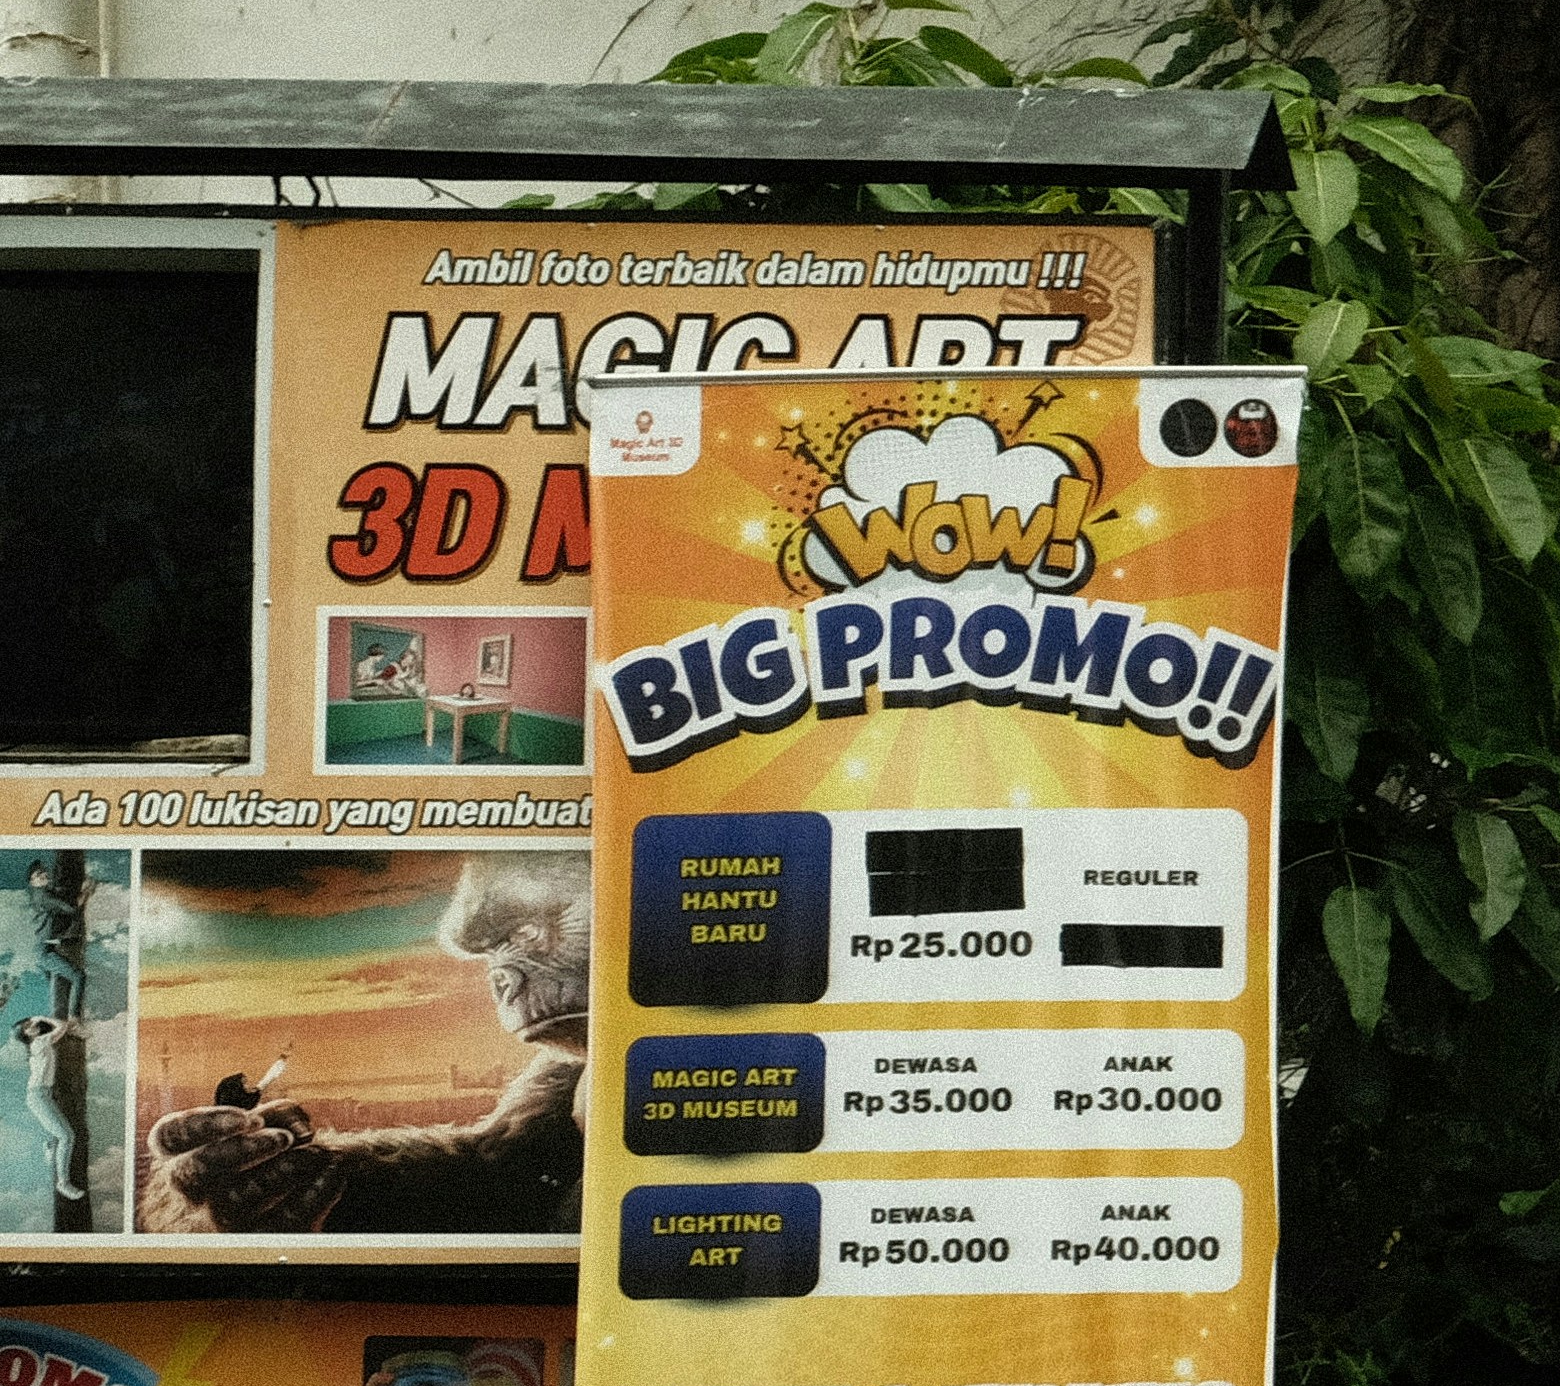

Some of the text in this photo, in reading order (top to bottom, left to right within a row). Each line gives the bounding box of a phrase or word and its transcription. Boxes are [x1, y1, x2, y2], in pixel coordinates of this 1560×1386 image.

[424, 249, 531, 286] Ambil
[538, 250, 610, 286] foto
[617, 251, 745, 285] terbaik
[753, 252, 864, 288] dalam
[870, 252, 1029, 292] hidupmu
[328, 461, 506, 584] 3D
[803, 474, 1093, 588] WOW!
[606, 592, 1276, 763] BIG PROMO!!
[35, 790, 592, 834] Ada 100 lukisan yang membuat
[680, 857, 781, 877] RUMAH
[1084, 870, 1200, 886] REGULER
[682, 890, 778, 912] HANTU
[691, 923, 766, 944] BARU
[875, 1057, 976, 1074] DEWASA
[1104, 1056, 1173, 1072] ANAK
[652, 1068, 797, 1088] MAGIC ART
[643, 1099, 798, 1119] 3D MUSEUM
[871, 1207, 974, 1224] DEWASA
[1101, 1205, 1170, 1221] ANAK
[652, 1214, 782, 1235] LIGHTING
[689, 1248, 742, 1266] ART
